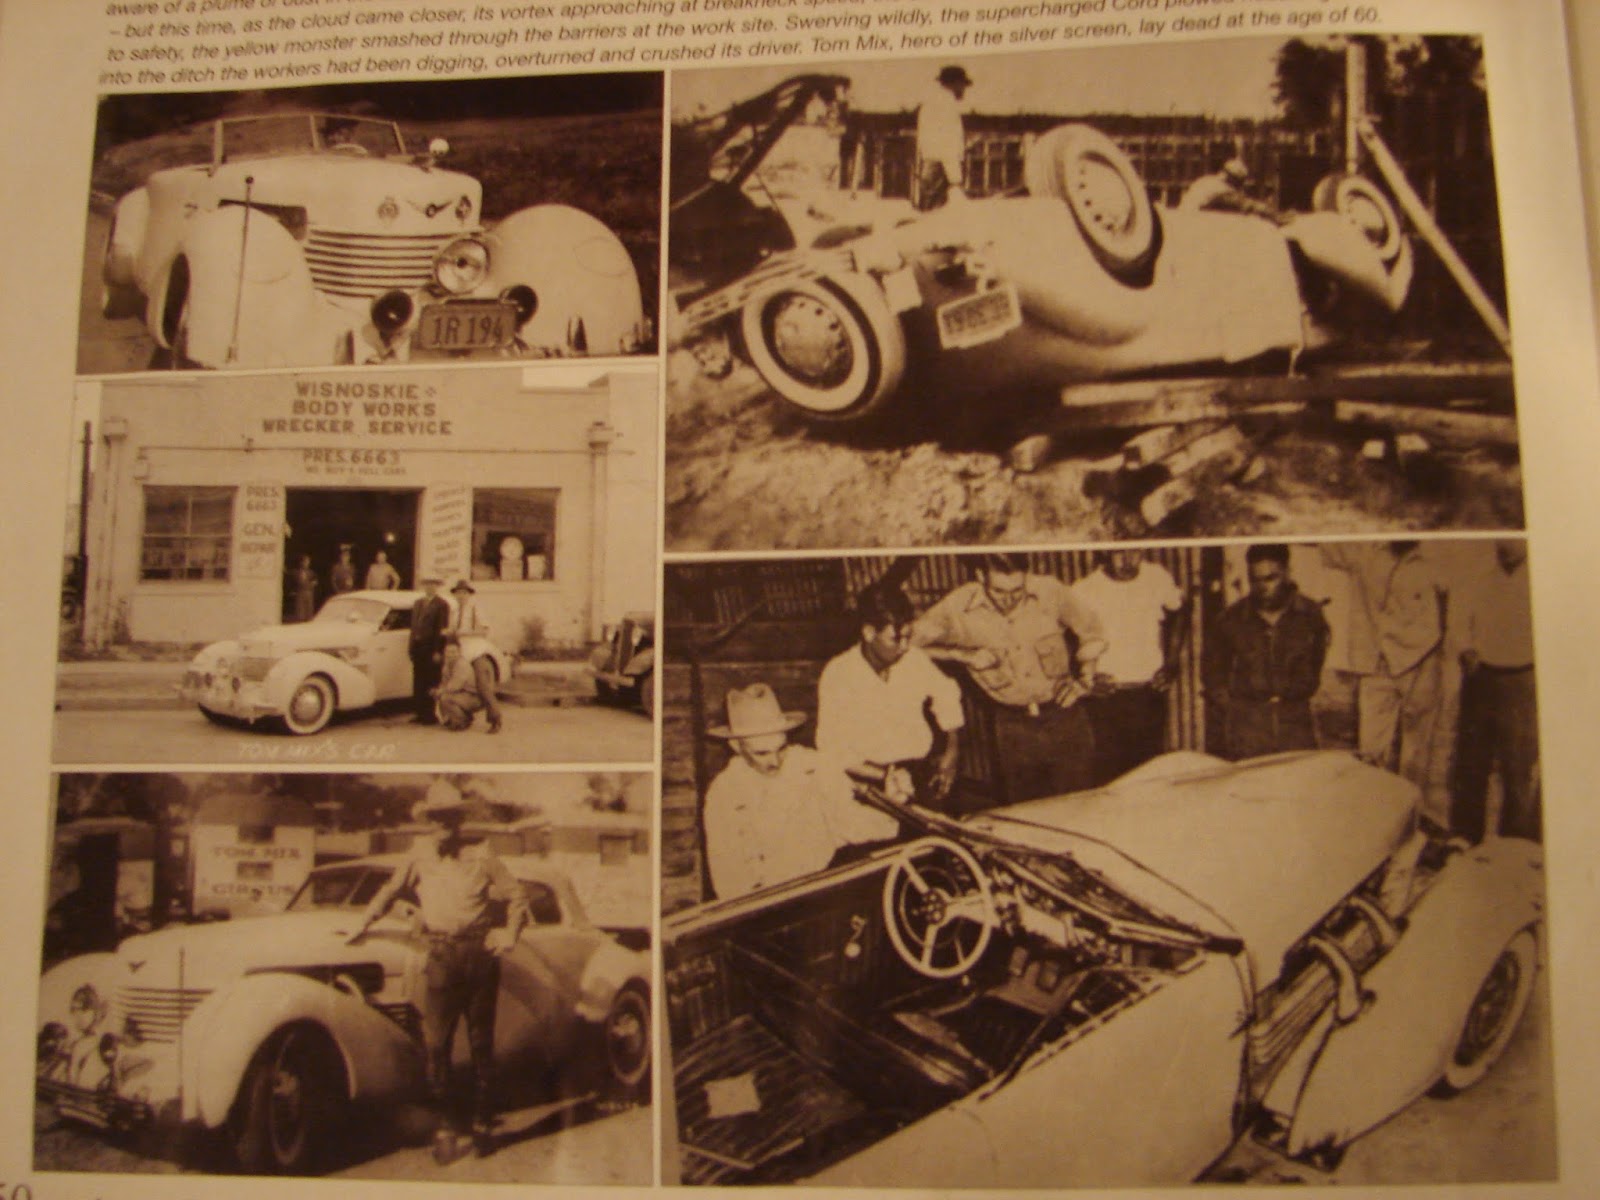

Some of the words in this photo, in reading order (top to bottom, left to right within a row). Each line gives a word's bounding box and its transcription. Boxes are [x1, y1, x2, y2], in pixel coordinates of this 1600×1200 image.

[106, 3, 159, 15] aware
[164, 0, 182, 13] of
[186, 1, 196, 12] a
[125, 24, 154, 37] but
[159, 23, 189, 36] this
[196, 22, 235, 36] time,
[243, 20, 262, 32] as
[269, 16, 296, 30] the
[301, 11, 350, 28] cloud
[355, 12, 404, 24] came
[410, 8, 465, 22] closer,
[474, 6, 494, 20] its
[501, 5, 554, 20] vortex
[561, 0, 675, 19] approaching
[681, 0, 698, 12] at
[107, 48, 125, 61] to
[130, 45, 184, 62] safety,
[192, 45, 219, 59] the
[225, 42, 278, 60] yellow
[284, 36, 355, 53] monster
[361, 32, 443, 48] smashed
[449, 29, 518, 47] through
[525, 28, 552, 42] the
[559, 25, 626, 40] barriers
[633, 24, 650, 37] at
[657, 22, 685, 37] the
[692, 19, 735, 35] work
[742, 18, 776, 32] site.
[786, 12, 871, 30] Swerving
[878, 9, 932, 26] wildly,
[941, 8, 969, 22] the
[976, 0, 1106, 23] supercharged
[100, 71, 132, 84] into
[138, 69, 166, 83] the
[171, 68, 214, 82] ditch
[221, 66, 248, 80] the
[254, 63, 321, 78] workers
[327, 58, 361, 73] had
[366, 58, 410, 71] been
[417, 55, 487, 73] digging,
[496, 48, 595, 66] overturned
[600, 47, 635, 61] and
[641, 44, 716, 60] crushed
[721, 44, 741, 57] its
[748, 41, 801, 56] driver.
[812, 37, 849, 52] Tom
[856, 34, 892, 51] Mix,
[901, 34, 943, 48] hero
[949, 31, 968, 46] of
[974, 30, 1003, 45] the
[1010, 27, 1057, 42] silver
[1064, 23, 1131, 38] screen,
[1140, 19, 1165, 36] lay
[1172, 14, 1221, 31] dead
[1227, 13, 1244, 27] at
[1252, 11, 1281, 25] the
[1288, 13, 1322, 28] age
[1329, 7, 1348, 22] of
[296, 381, 419, 400] WISNOSKIE
[292, 399, 353, 416] BODY
[363, 402, 436, 417] WORKS
[262, 418, 354, 434] WRECKER
[368, 420, 452, 435] SERVICE
